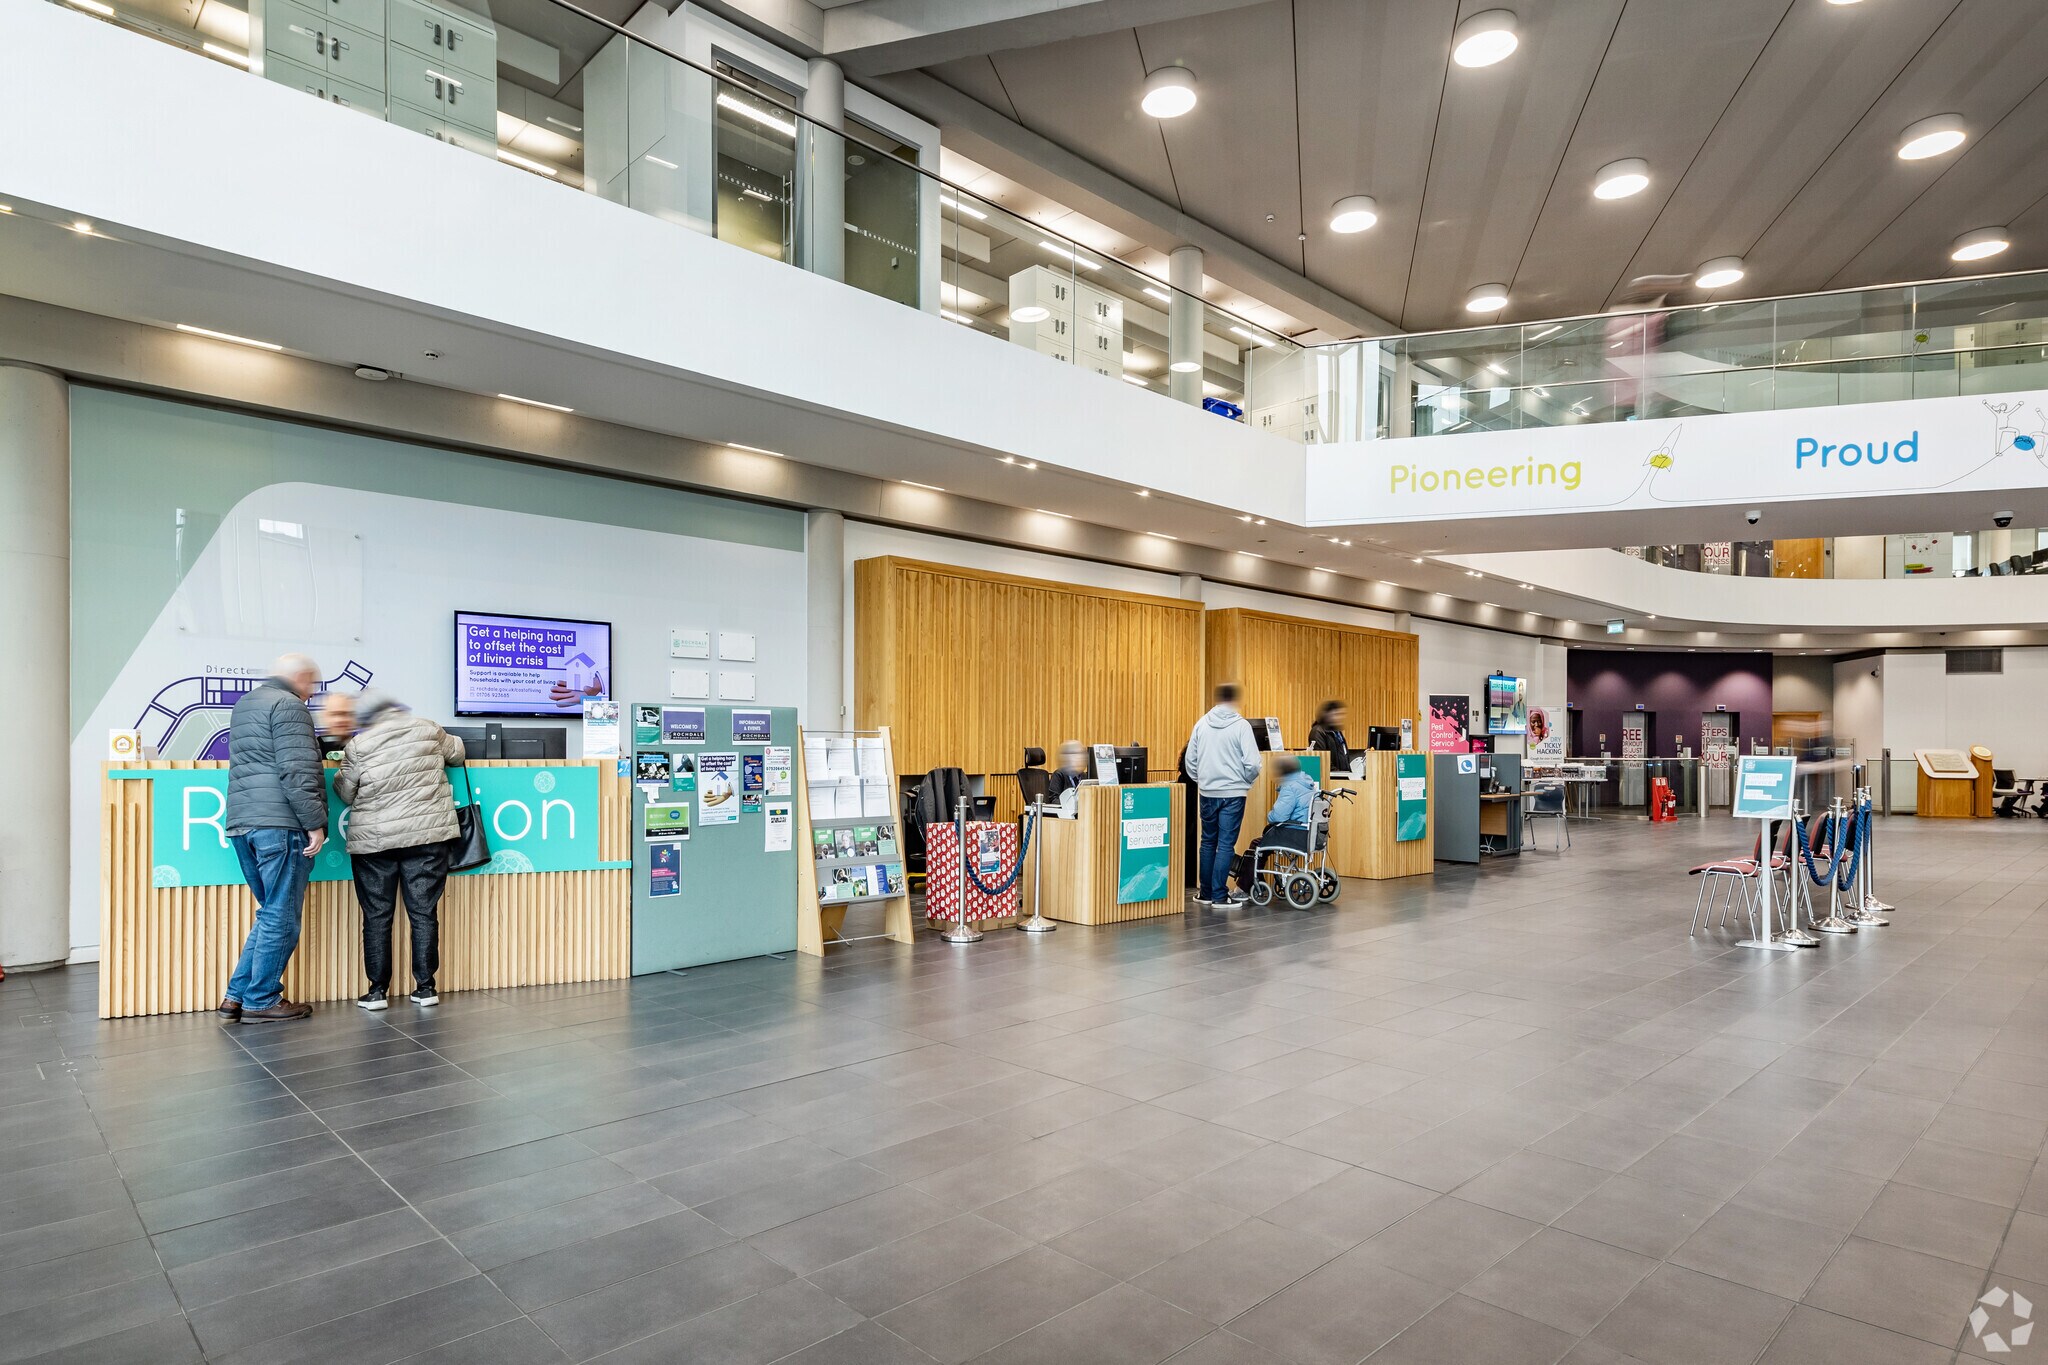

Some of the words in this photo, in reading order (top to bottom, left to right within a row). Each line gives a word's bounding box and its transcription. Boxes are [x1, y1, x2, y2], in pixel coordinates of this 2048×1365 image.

[1795, 430, 1919, 469] Proud
[1389, 456, 1582, 494] Pioneering
[1703, 547, 1730, 557] OUR
[469, 626, 490, 638] Get
[493, 630, 500, 638] a
[503, 628, 544, 643] helping
[547, 631, 574, 643] hand
[469, 639, 481, 649] to
[484, 641, 516, 652] offset
[519, 643, 537, 653] the
[539, 645, 562, 654] cost
[469, 652, 481, 662] of
[483, 653, 512, 666] living
[515, 655, 544, 666] crisis
[1431, 731, 1454, 739] Control
[1622, 729, 1642, 741] REE
[1400, 780, 1424, 788] Customer
[1403, 790, 1422, 798] services
[1126, 821, 1166, 833] Customer
[1129, 835, 1162, 846] services
